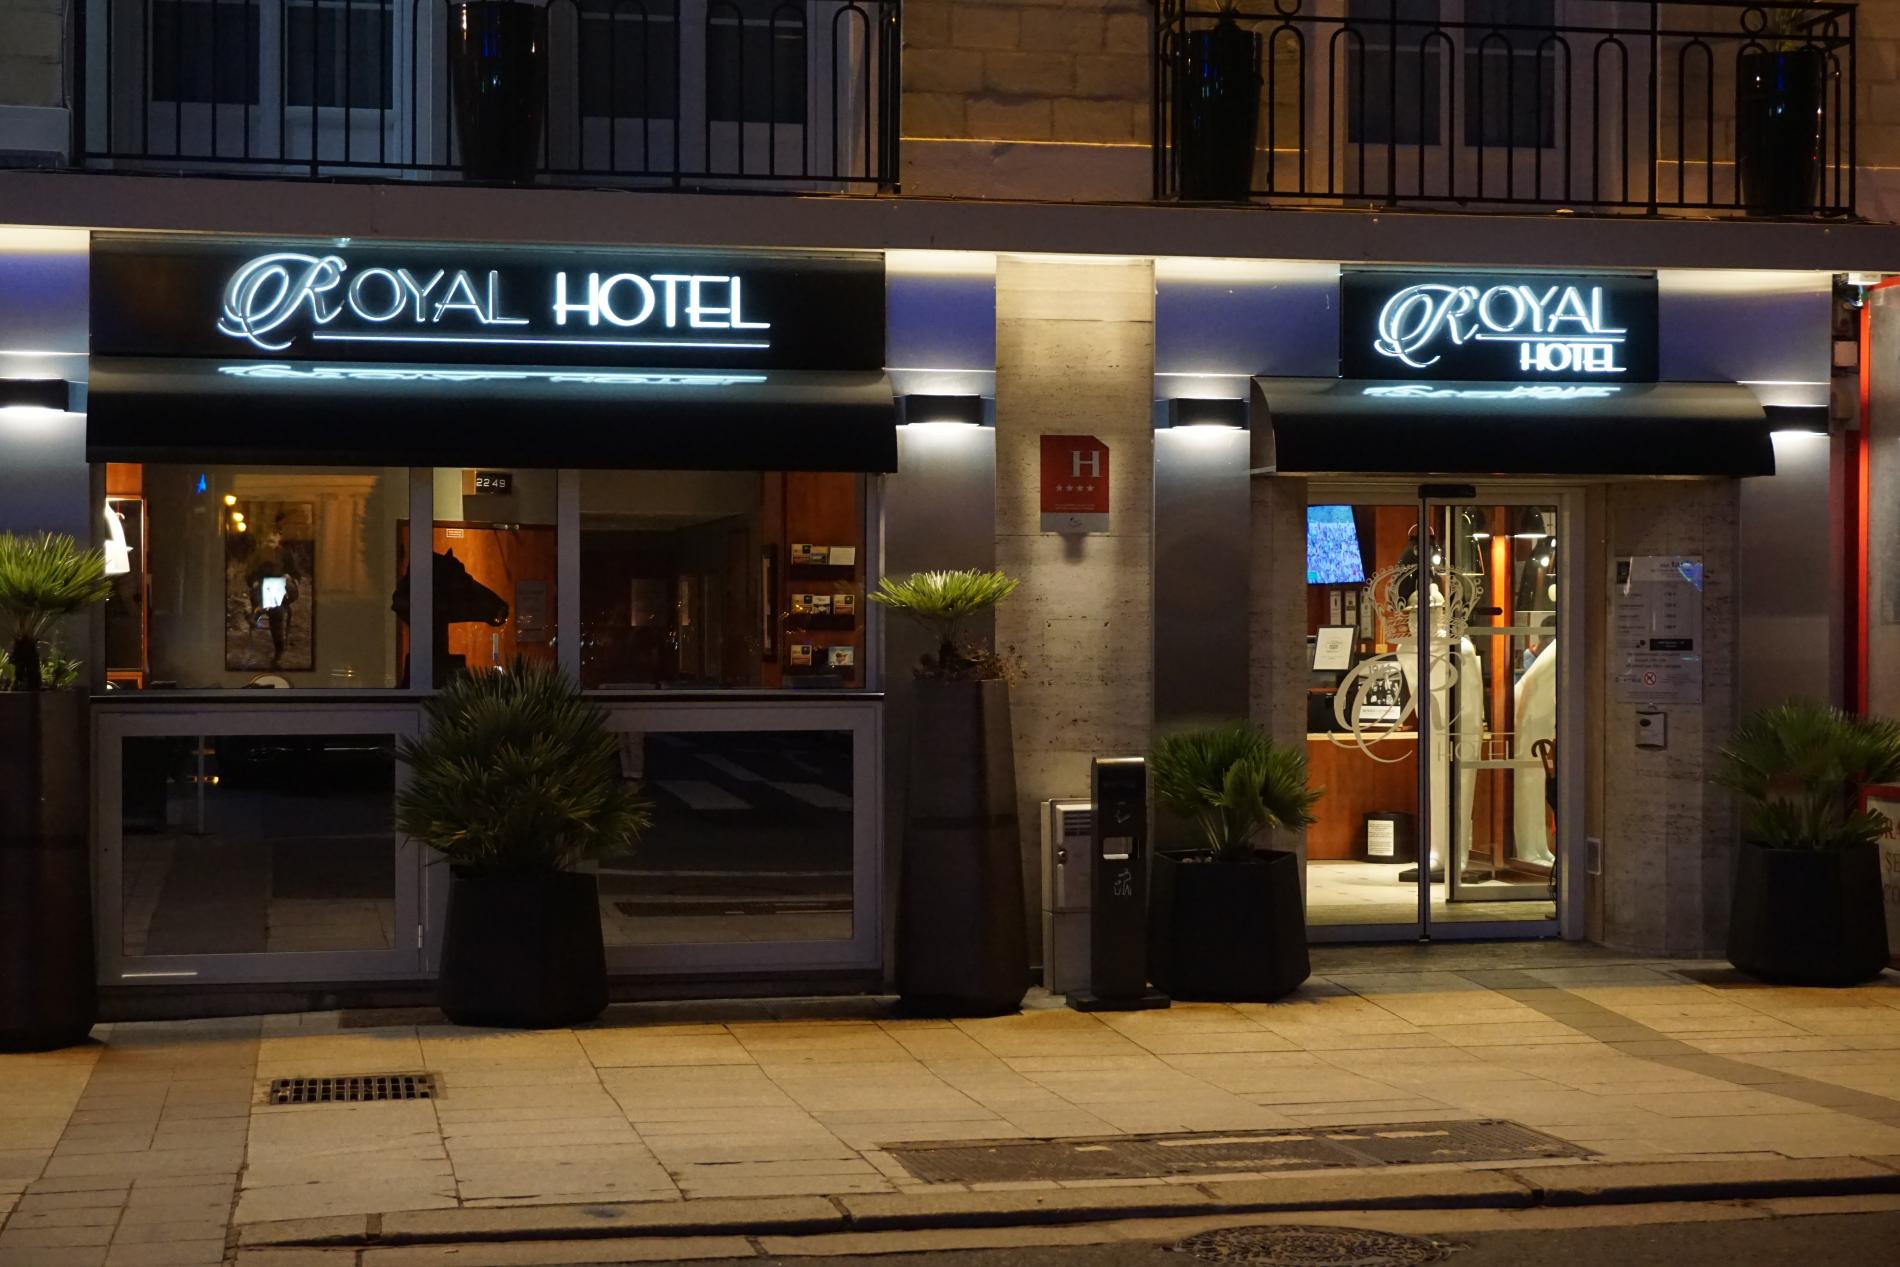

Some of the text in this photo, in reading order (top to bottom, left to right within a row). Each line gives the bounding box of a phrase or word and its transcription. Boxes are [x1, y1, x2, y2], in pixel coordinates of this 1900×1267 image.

[218, 252, 770, 350] ROYAL HOTEL
[1374, 283, 1627, 368] ROYAL
[1519, 342, 1627, 371] HOTEL
[1072, 450, 1100, 477] H
